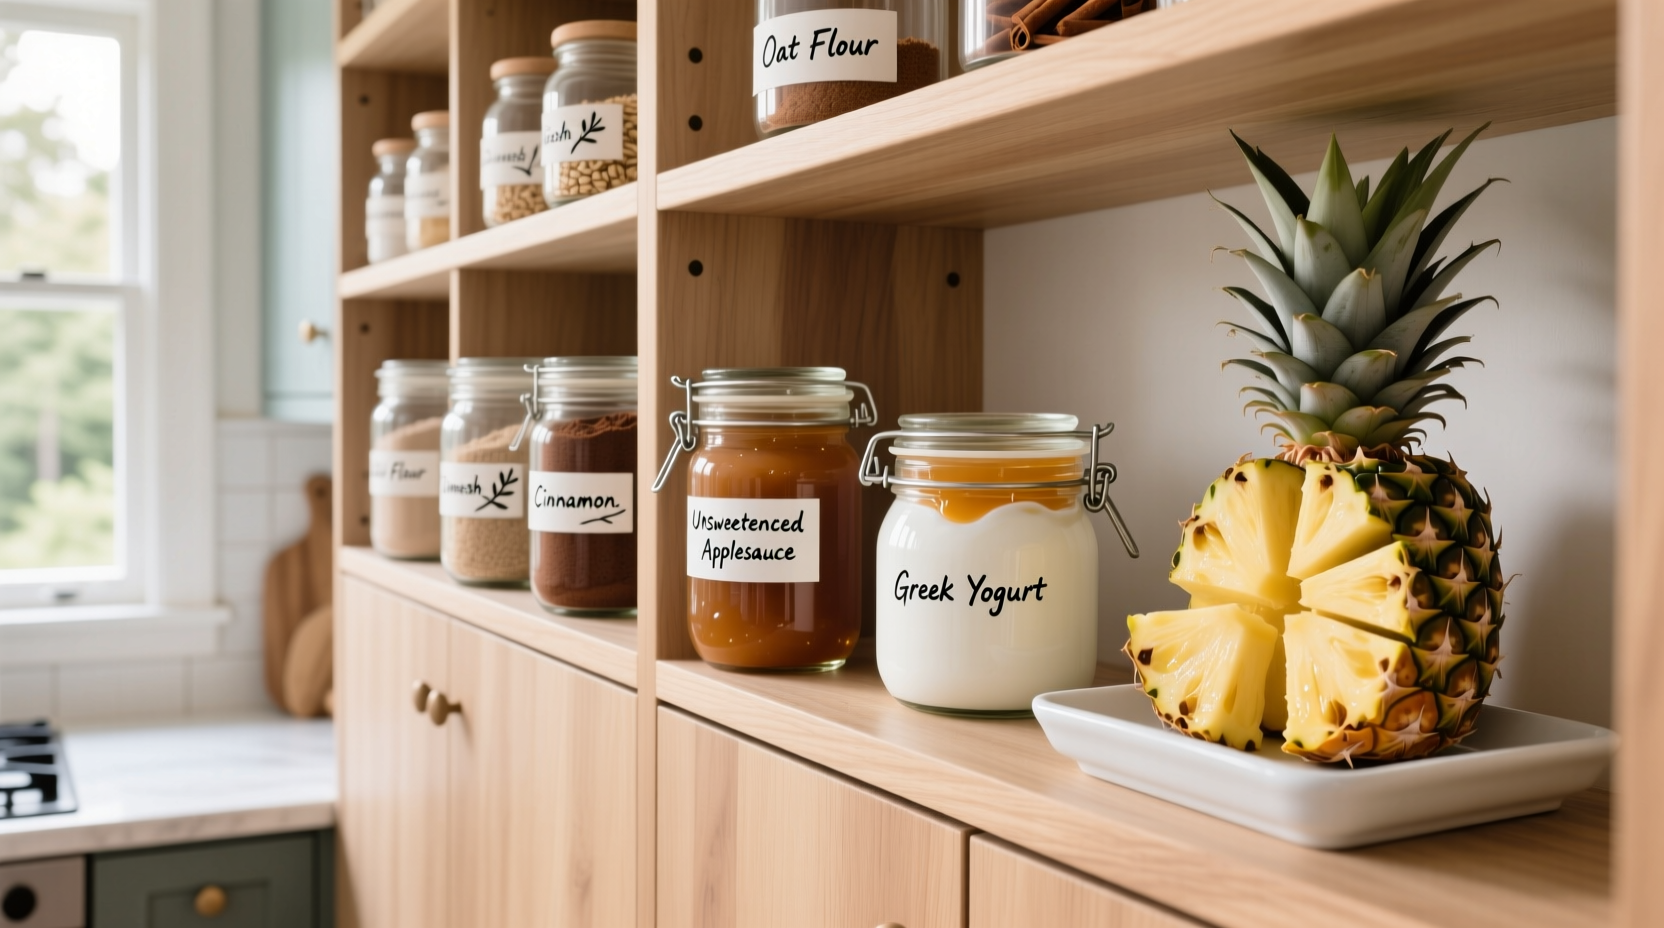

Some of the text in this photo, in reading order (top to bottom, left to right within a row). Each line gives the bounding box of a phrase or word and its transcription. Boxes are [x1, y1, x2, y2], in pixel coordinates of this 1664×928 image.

[762, 27, 879, 68] Oat Flour
[701, 537, 796, 570] Applesauce
[894, 569, 1048, 617] Greek Yogurt
